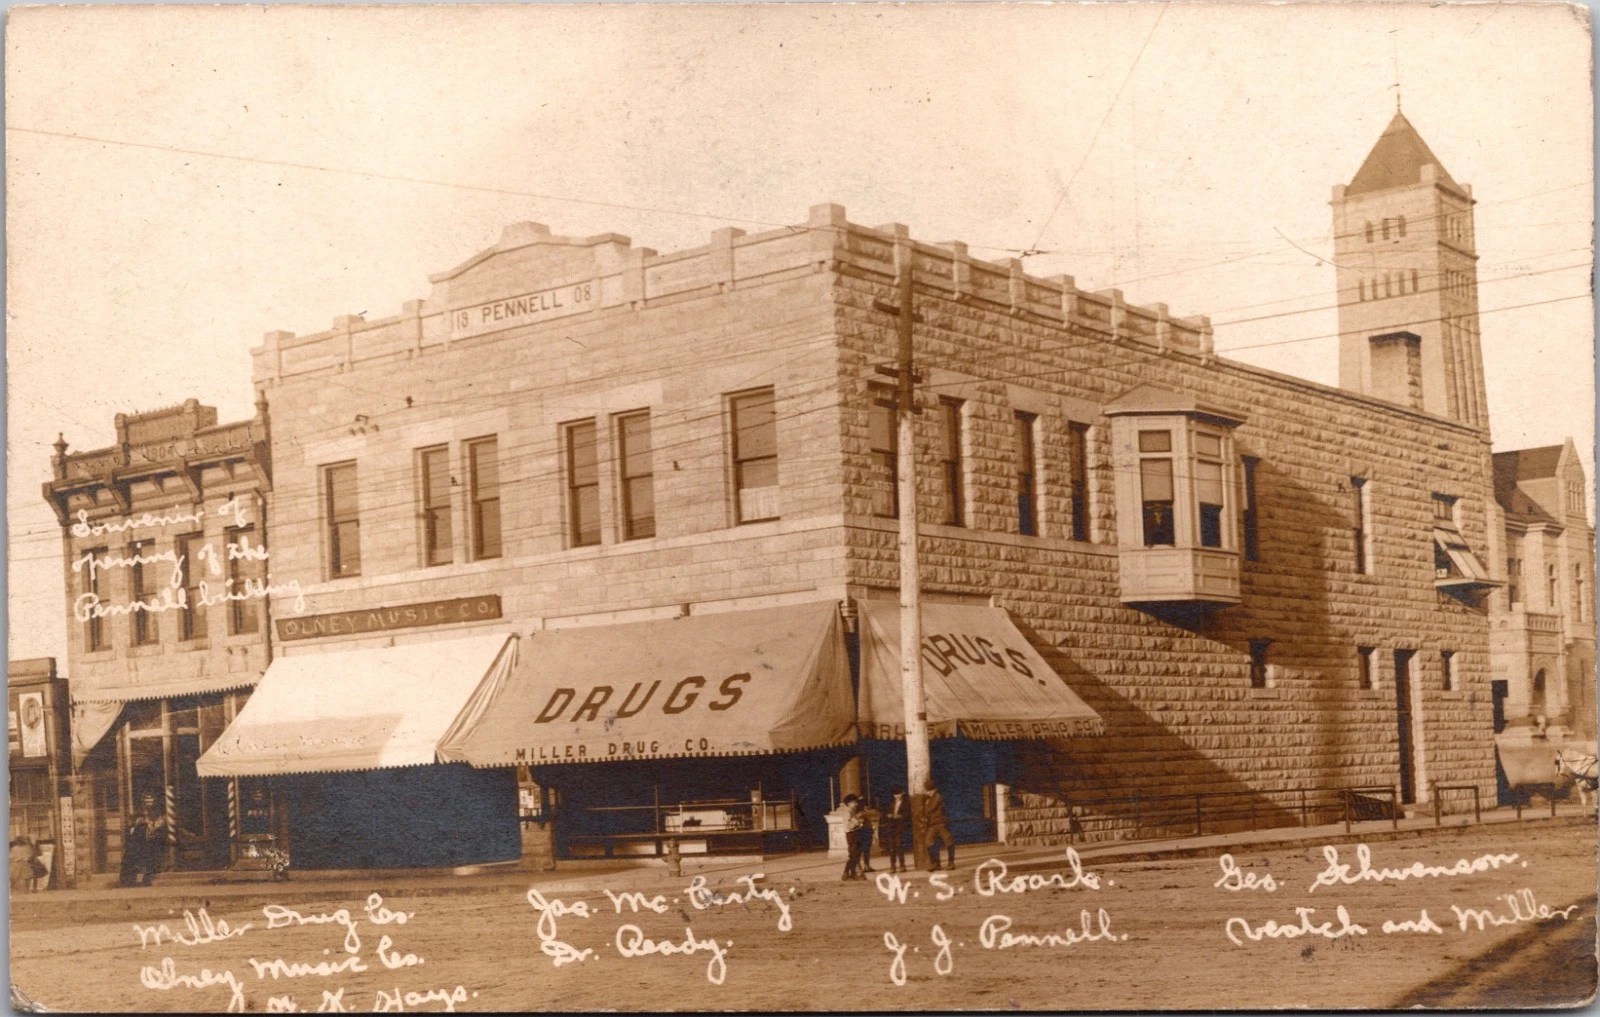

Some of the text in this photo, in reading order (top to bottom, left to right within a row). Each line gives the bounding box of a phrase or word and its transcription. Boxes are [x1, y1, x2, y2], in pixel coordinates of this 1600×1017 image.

[482, 291, 563, 323] PENNELL
[574, 284, 592, 303] 08
[285, 616, 357, 635] OLNEY
[367, 605, 444, 629] MUSIC
[533, 672, 751, 724] DRUGS
[970, 723, 1024, 735] MILLER
[1031, 721, 1068, 734] DRUG
[516, 737, 715, 760] MILLER DRUG CO.
